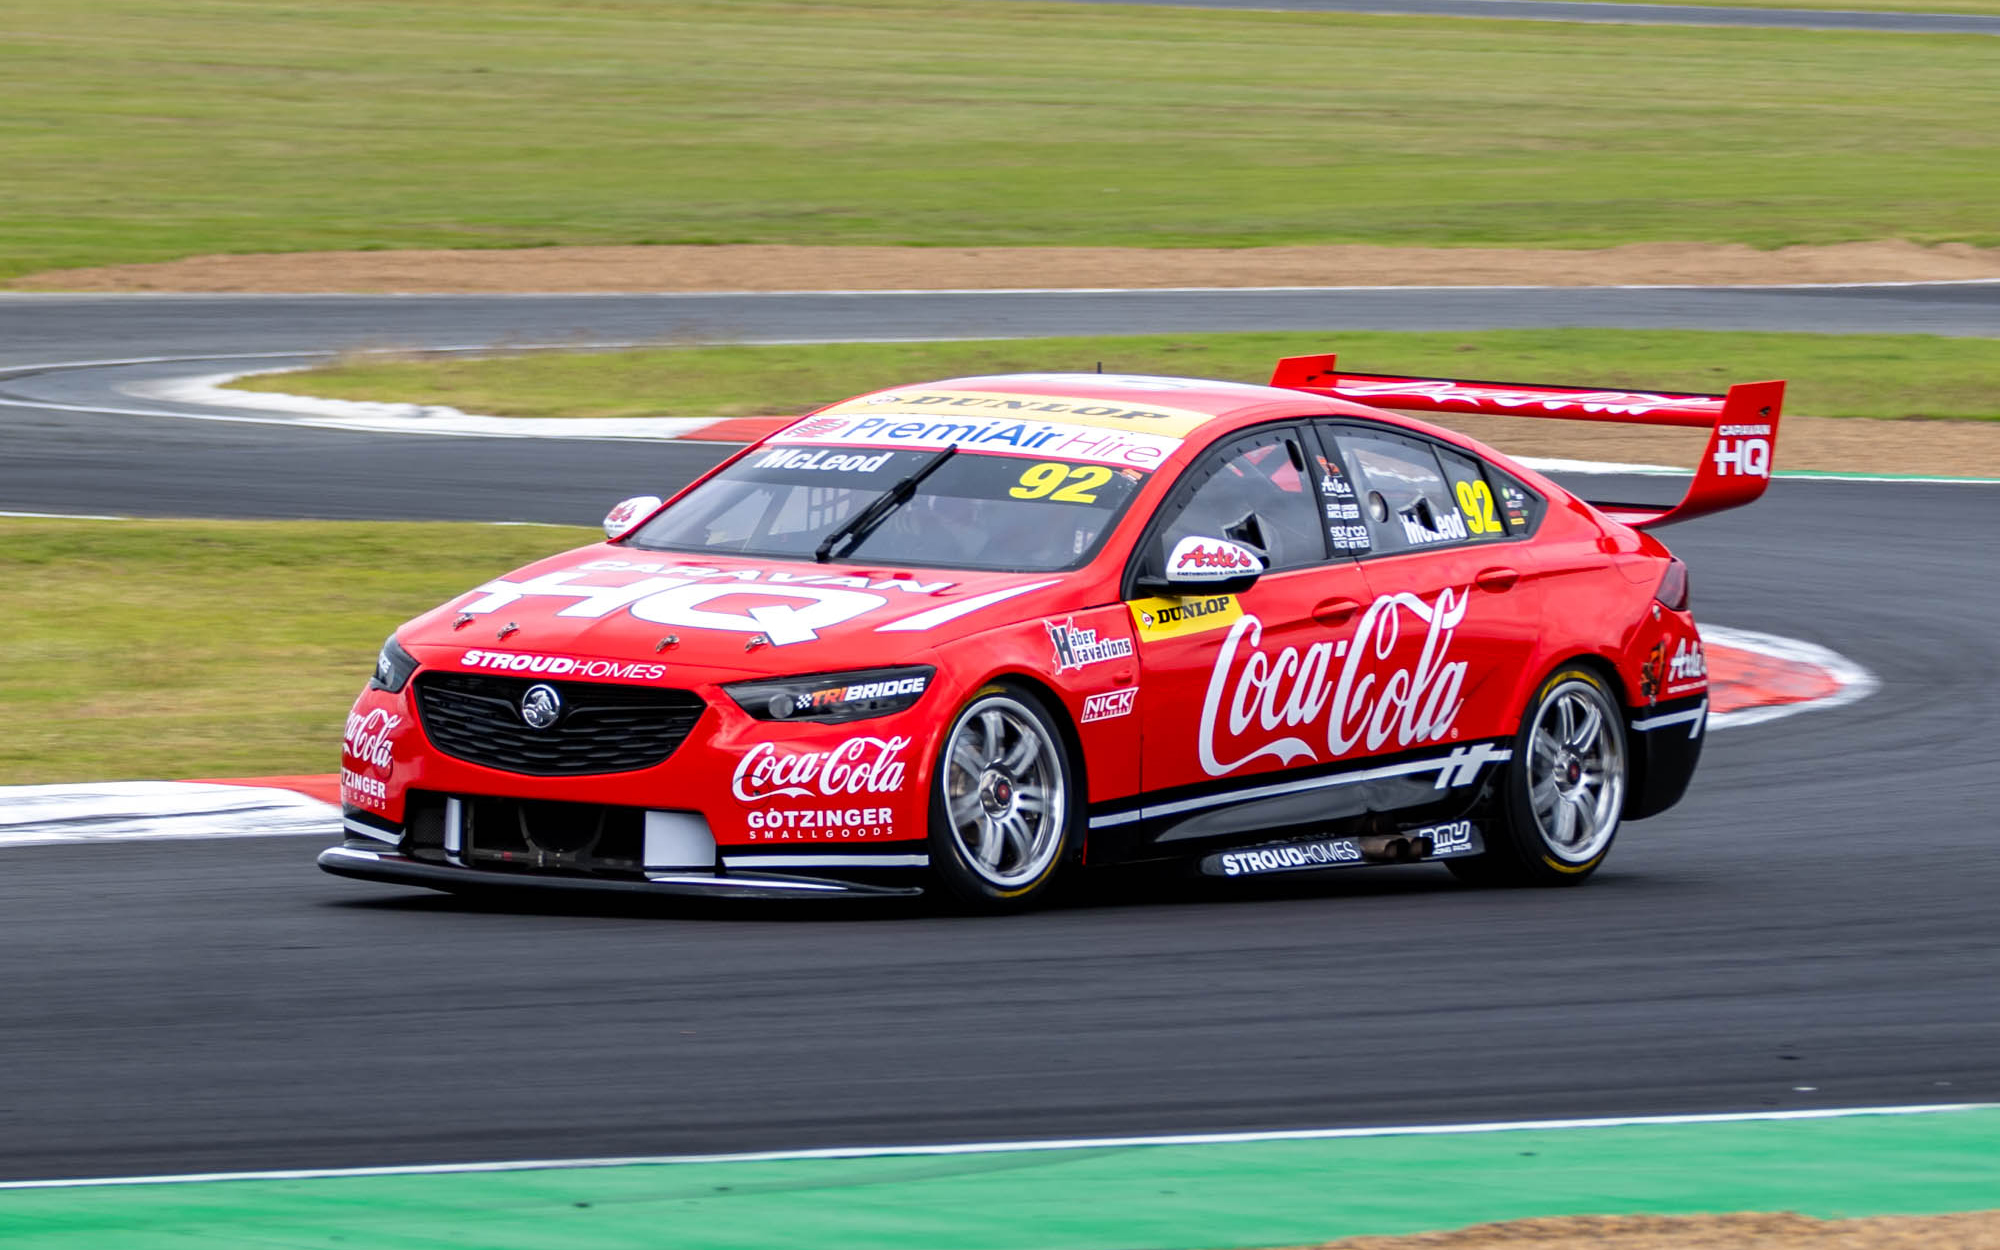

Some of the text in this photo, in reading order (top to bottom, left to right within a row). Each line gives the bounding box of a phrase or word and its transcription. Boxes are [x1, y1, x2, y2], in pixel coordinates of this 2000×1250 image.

[906, 395, 1170, 420] DUNLOP
[844, 417, 1064, 449] PremiAir
[1056, 431, 1164, 465] Hire
[1713, 438, 1770, 479] HQ
[754, 449, 894, 473] McLeod
[1008, 462, 1114, 504] 92
[1455, 479, 1503, 534] 92
[1400, 506, 1468, 544] Mceod
[1177, 544, 1252, 568] Axle's
[580, 561, 954, 595] CARAVAN
[460, 571, 888, 646] HQ
[1157, 597, 1230, 624] DUNLOP
[811, 677, 926, 707] TRIBRIDGE
[1199, 586, 1470, 776] Coca-Cola
[1086, 692, 1132, 715] NICK
[732, 735, 912, 802] Coca-Cola
[749, 826, 893, 840] SMALLGOODS
